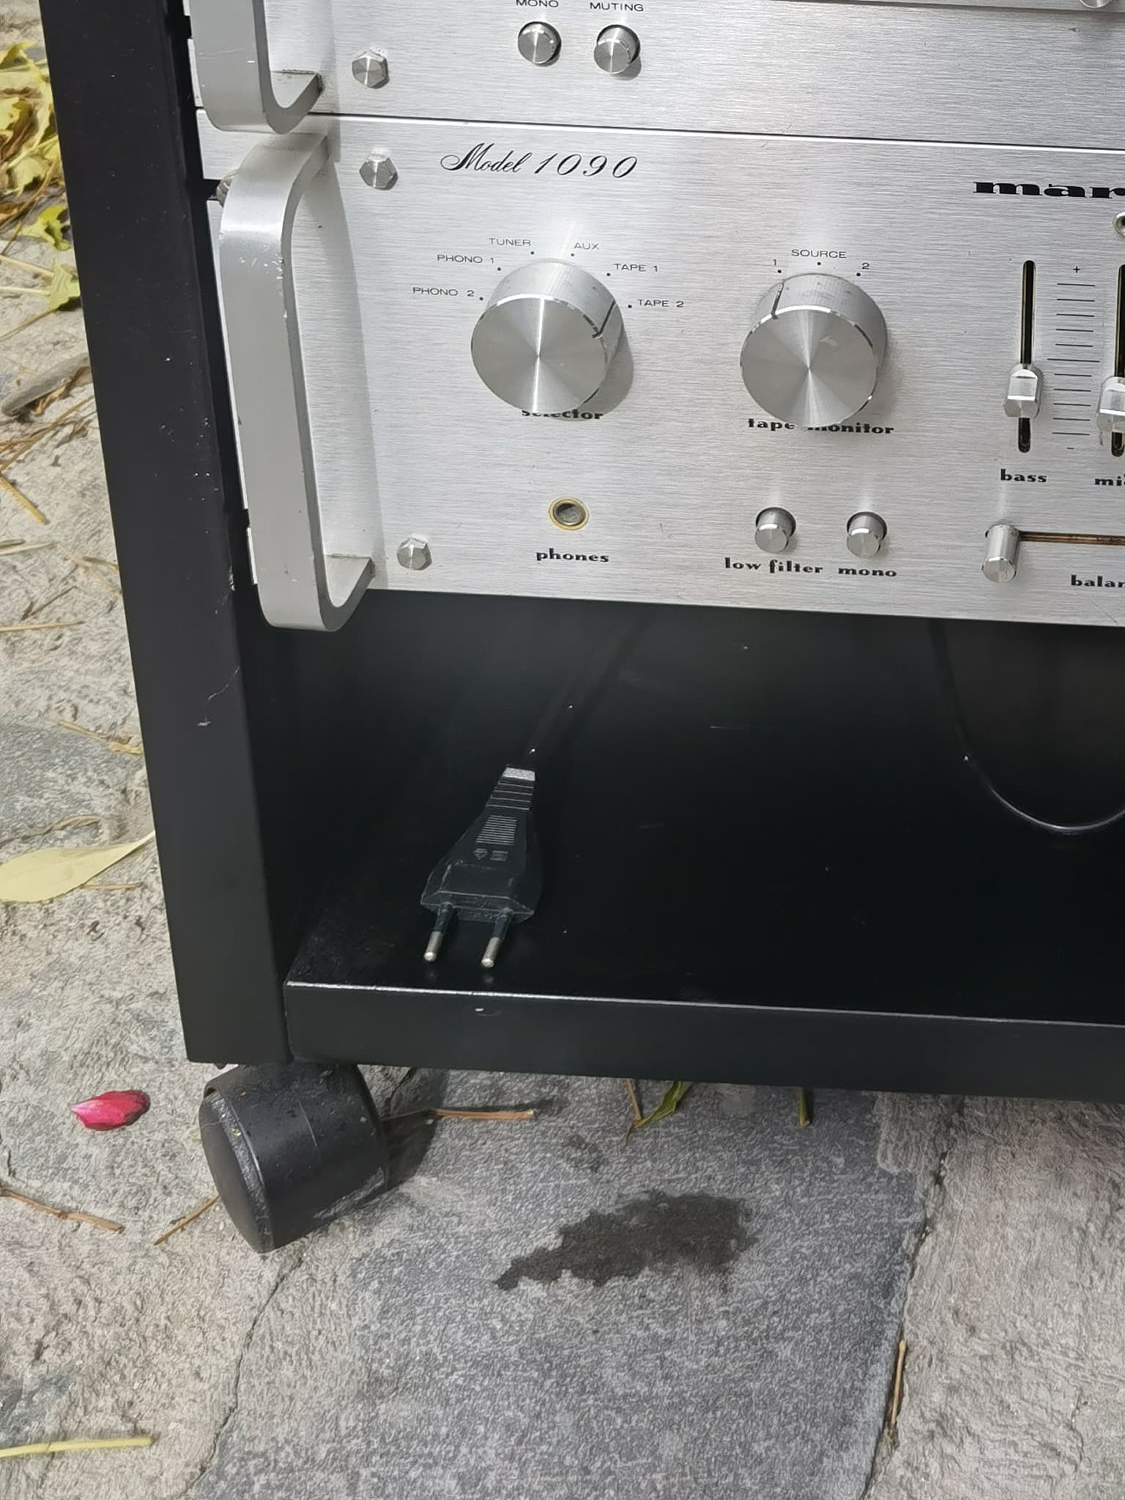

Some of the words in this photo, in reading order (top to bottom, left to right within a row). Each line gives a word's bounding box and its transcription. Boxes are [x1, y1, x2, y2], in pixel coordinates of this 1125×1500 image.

[589, 1, 644, 12] MUTING
[440, 142, 532, 173] Model
[534, 153, 637, 178] 1090
[488, 238, 531, 247] TUNER
[574, 242, 599, 250] AUX
[437, 254, 483, 263] PHONO
[791, 249, 847, 258] SOURCE
[614, 263, 646, 272] TAPE
[412, 287, 458, 296] PHONO
[637, 299, 670, 307] TAPE
[748, 419, 795, 431] tape
[1000, 469, 1047, 483] bass
[536, 547, 609, 563] phones
[724, 556, 761, 572] low
[769, 559, 823, 575] filter
[838, 566, 897, 577] mono
